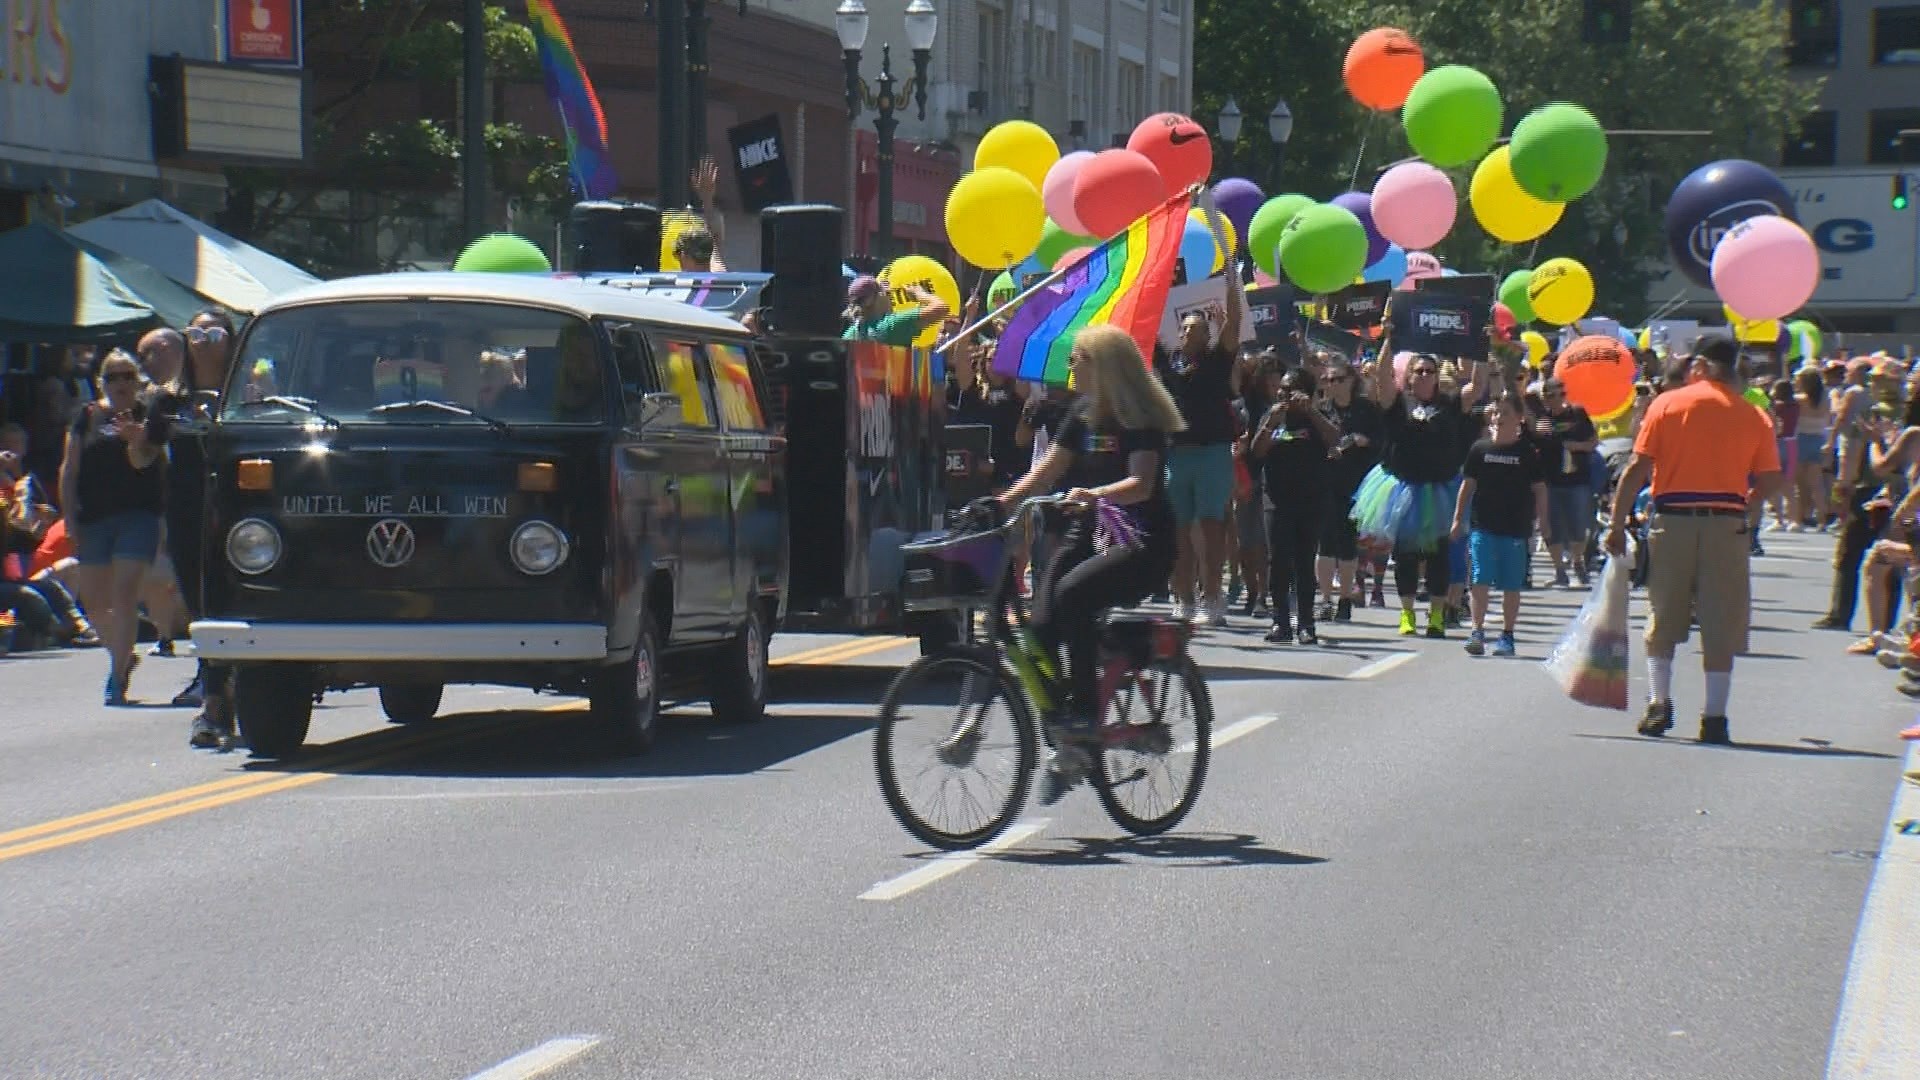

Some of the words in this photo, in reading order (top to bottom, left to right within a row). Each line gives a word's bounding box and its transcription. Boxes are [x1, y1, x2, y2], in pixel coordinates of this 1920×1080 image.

[738, 137, 779, 169] NIKE
[283, 496, 350, 515] UNTIL
[365, 496, 393, 514] WE
[408, 496, 449, 514] ALL
[464, 497, 507, 515] WIN
